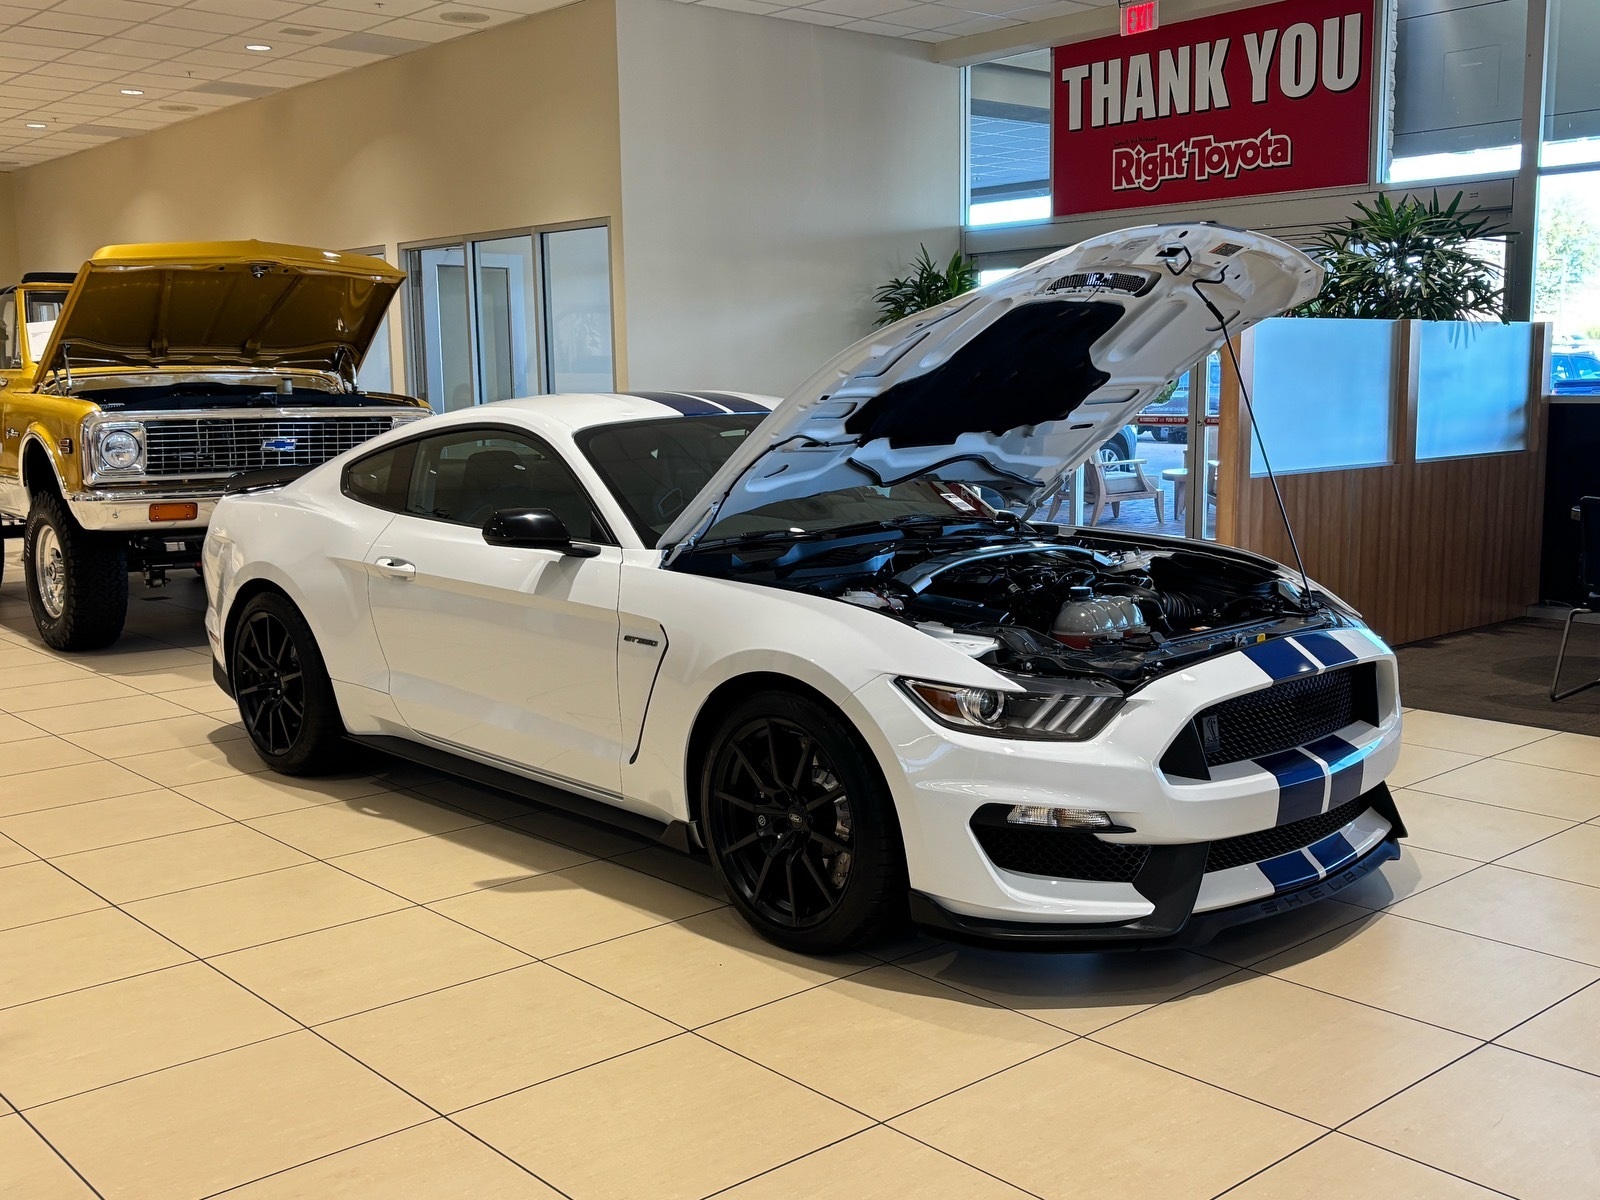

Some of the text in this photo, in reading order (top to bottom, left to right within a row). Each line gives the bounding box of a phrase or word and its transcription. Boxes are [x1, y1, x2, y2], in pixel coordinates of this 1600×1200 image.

[1127, 2, 1154, 35] EXIT
[1062, 12, 1361, 131] THANK YOU
[1112, 128, 1292, 192] Right Toyota
[1260, 863, 1369, 914] SHELBY
